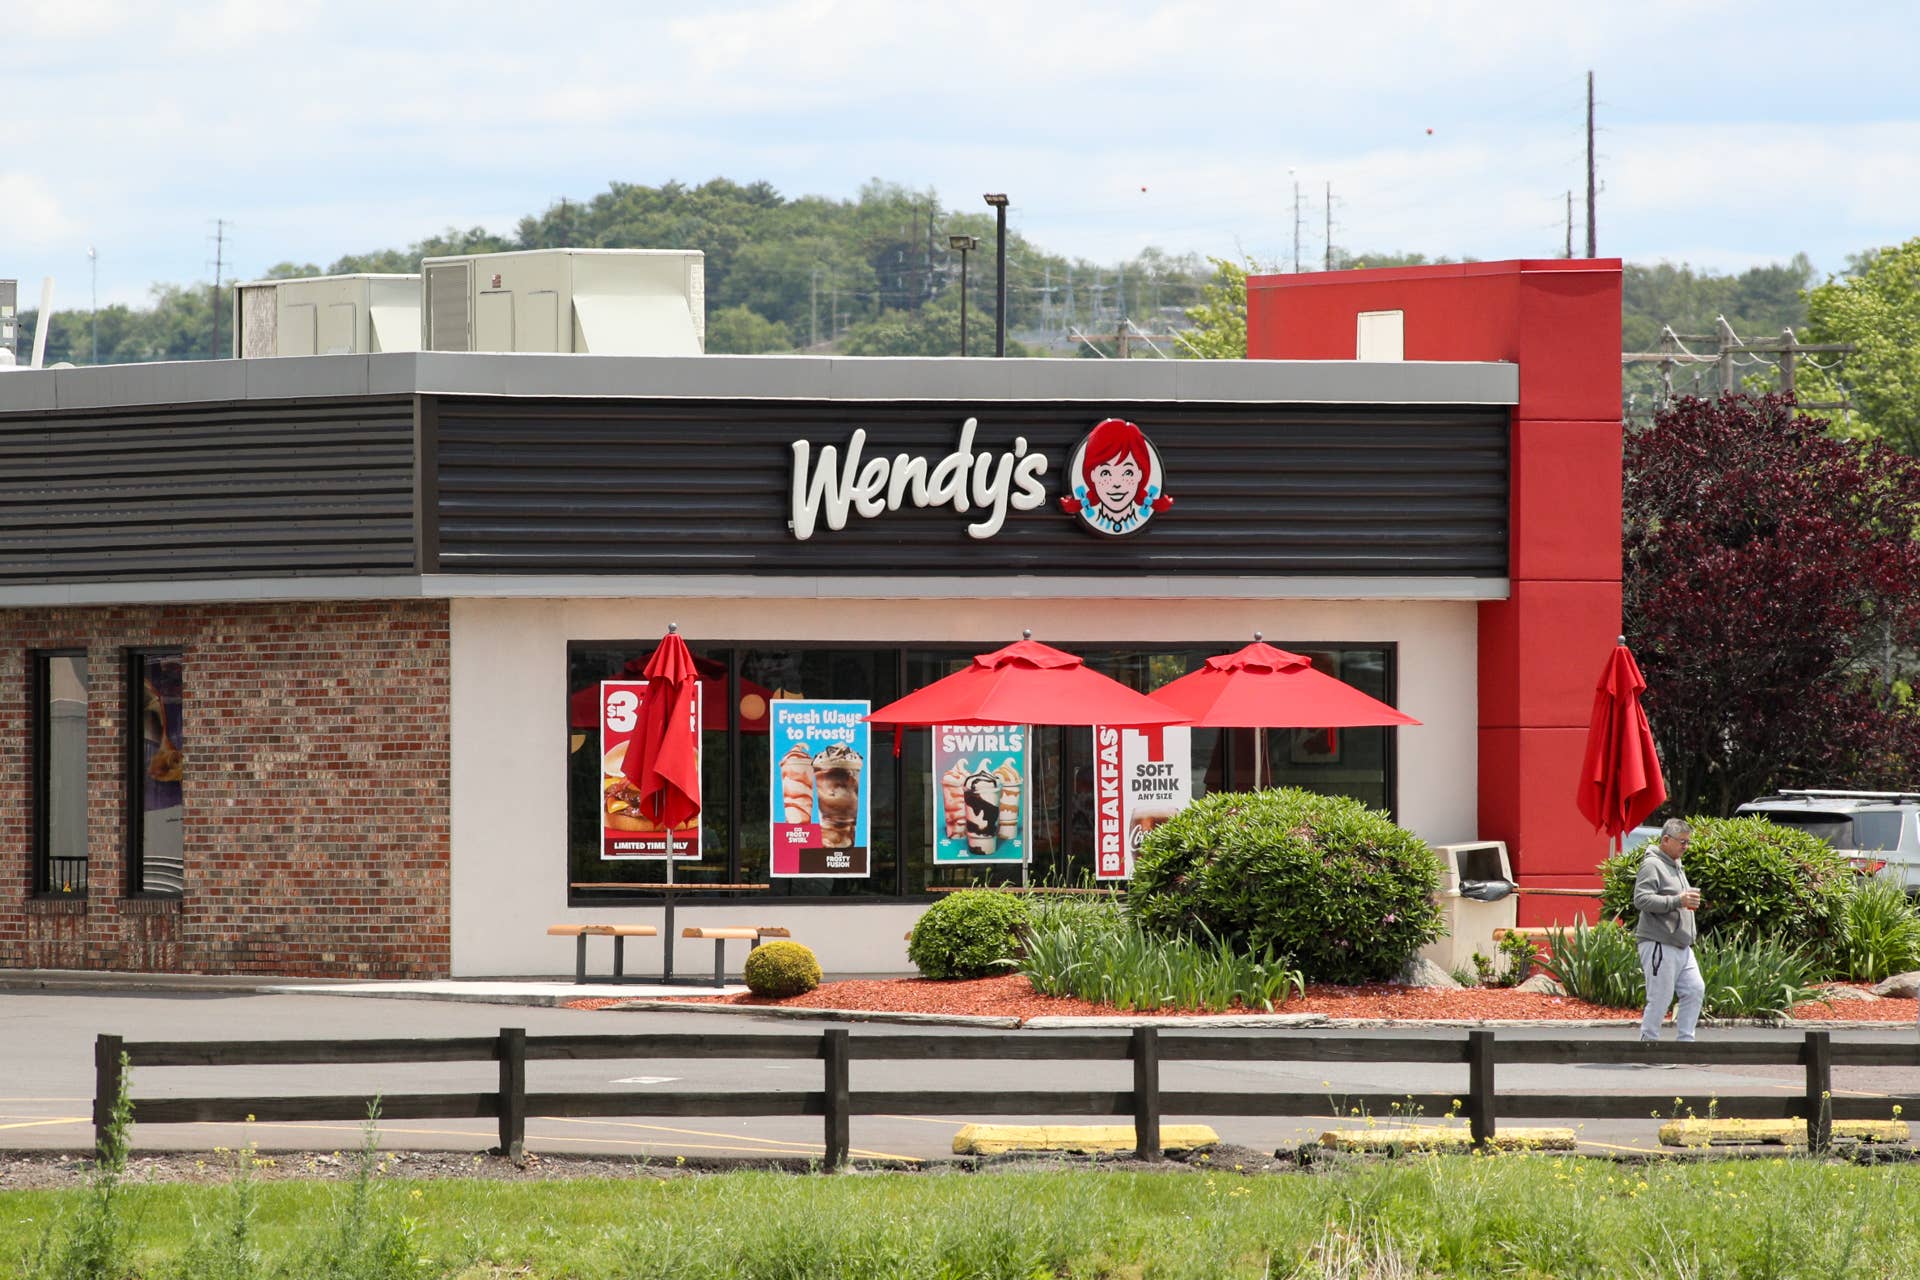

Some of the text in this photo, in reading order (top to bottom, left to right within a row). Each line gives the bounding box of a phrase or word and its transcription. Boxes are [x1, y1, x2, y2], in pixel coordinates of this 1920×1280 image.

[792, 417, 1048, 541] Wendy's
[778, 708, 863, 728] Fresh Ways
[786, 725, 856, 743] to Frosty
[942, 734, 1022, 752] SWIRLS
[1136, 764, 1174, 777] SOFT
[1131, 778, 1179, 792] DRINK
[1101, 726, 1120, 871] BREAKFAS
[614, 842, 688, 850] LIMITED TIME NLY
